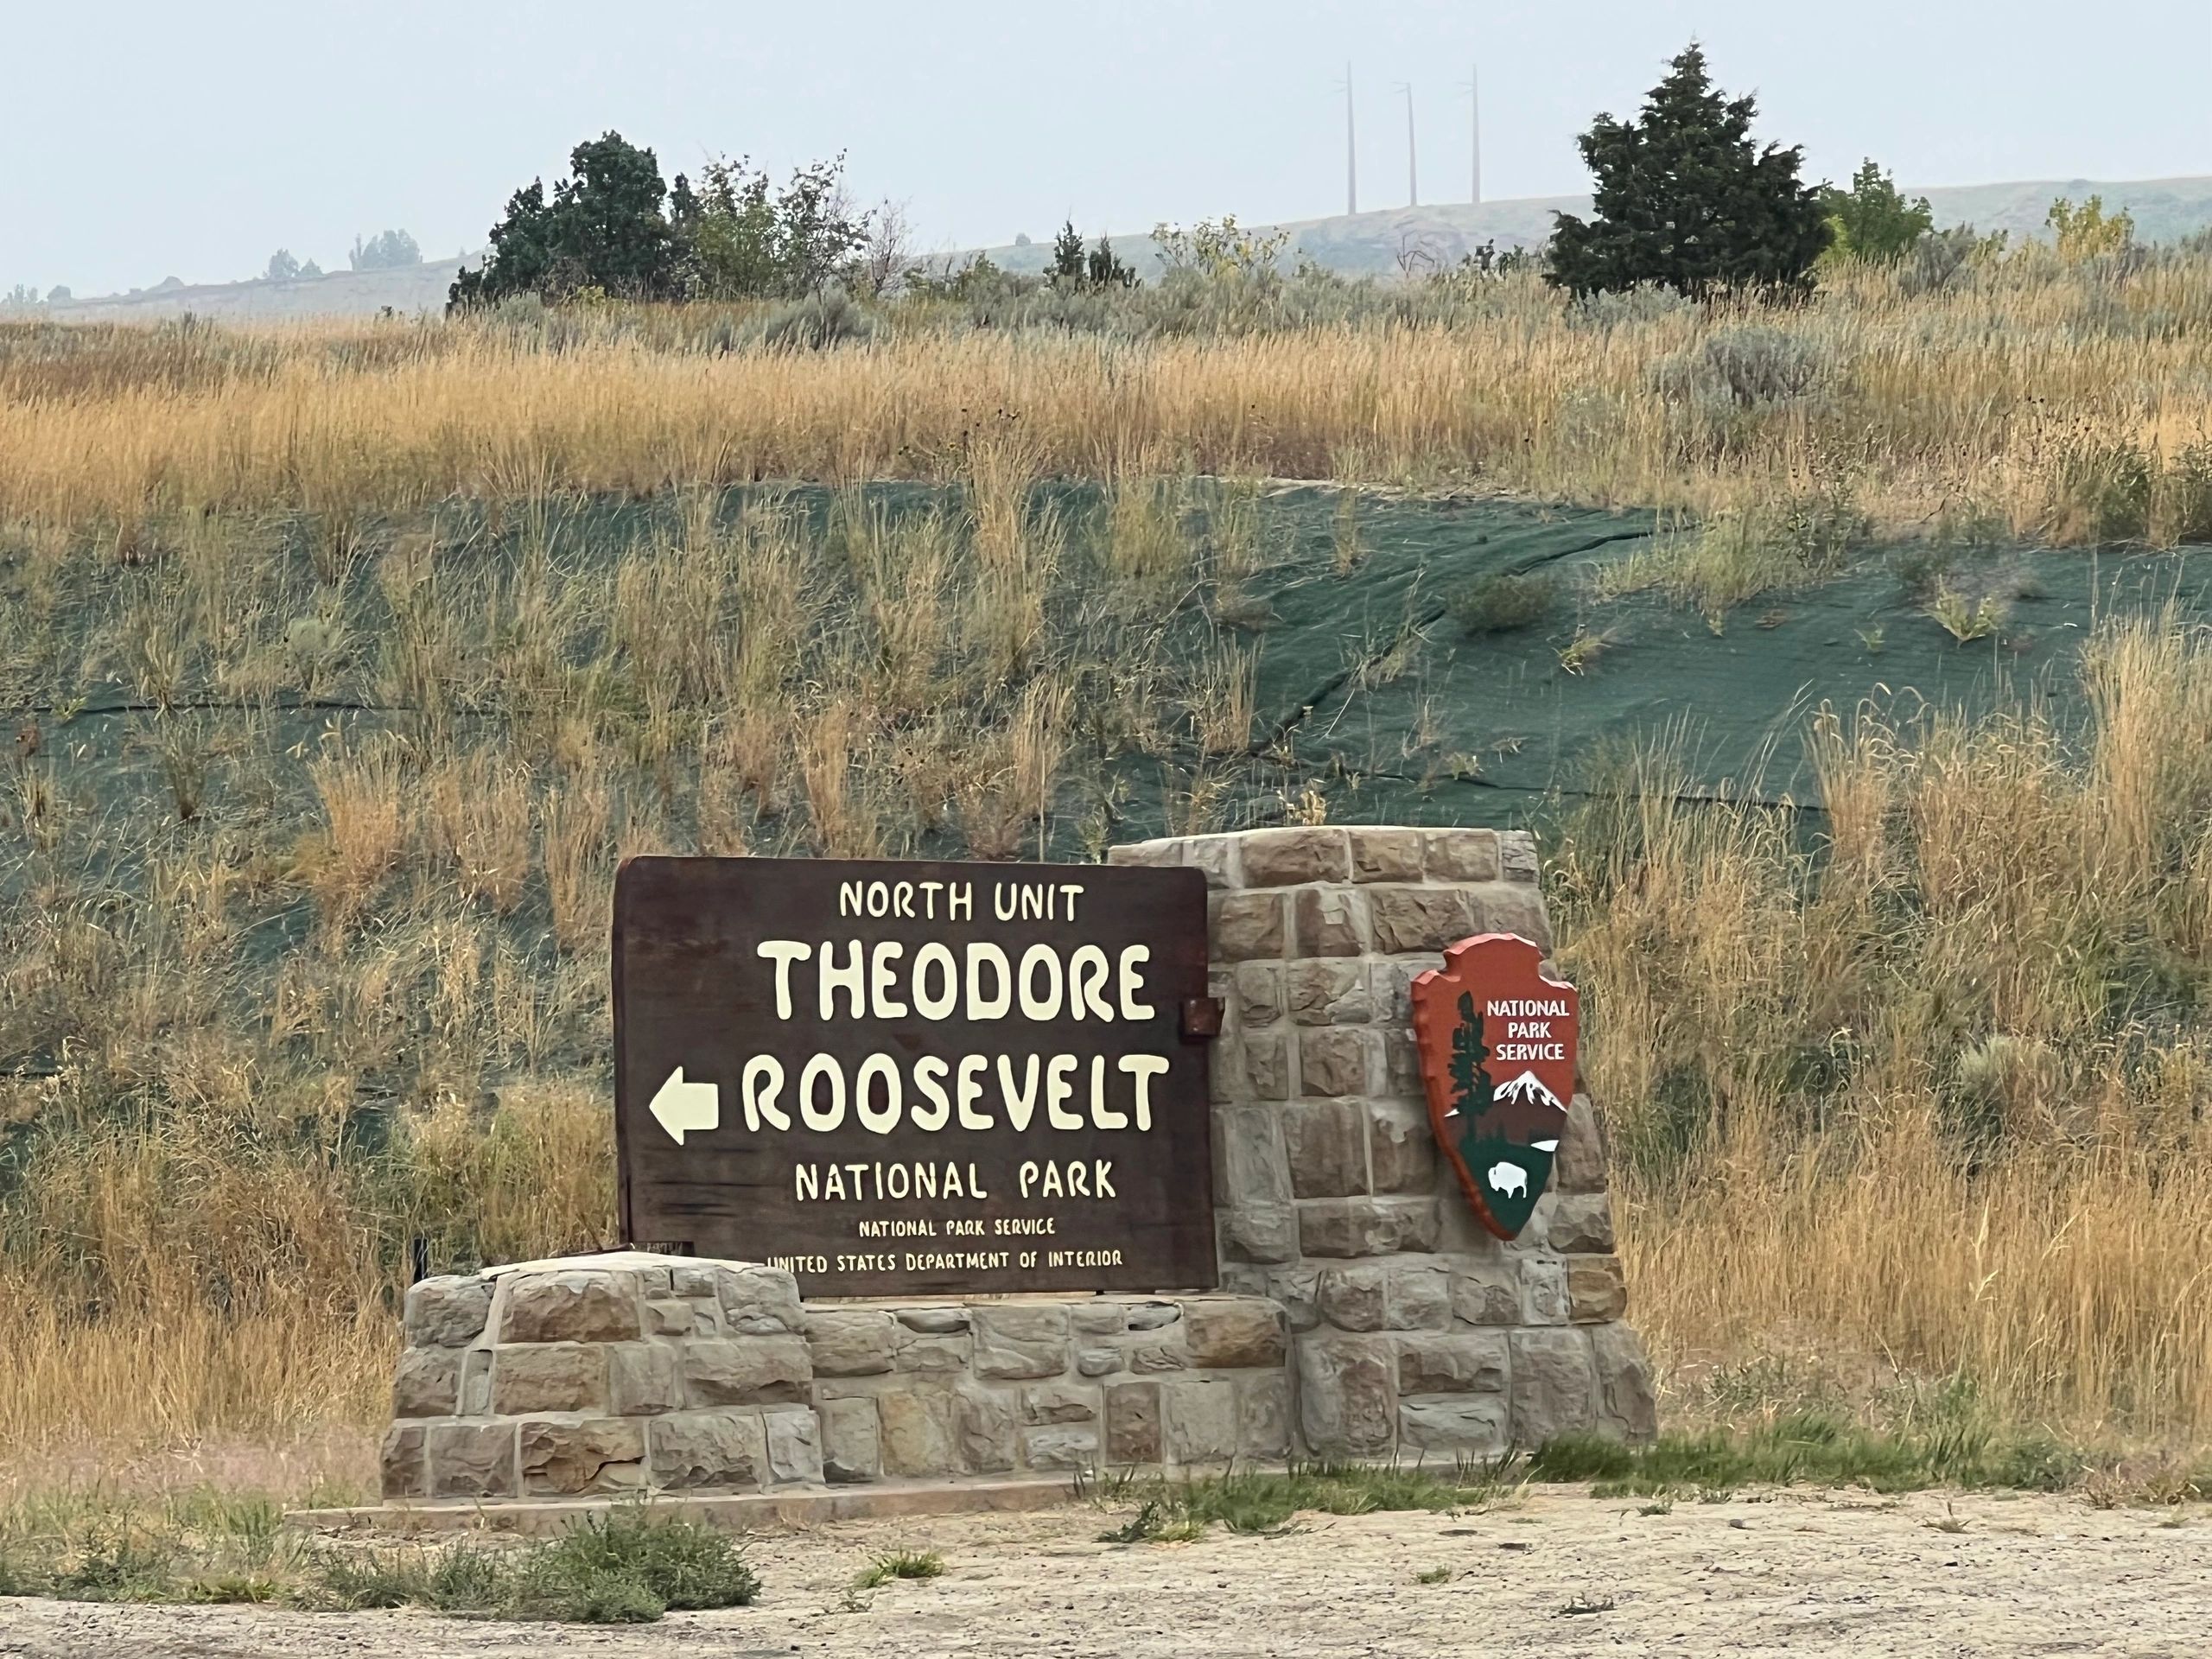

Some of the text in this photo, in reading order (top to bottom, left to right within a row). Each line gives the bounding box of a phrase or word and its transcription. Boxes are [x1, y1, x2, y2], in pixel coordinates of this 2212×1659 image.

[840, 881, 1084, 921] NORTH UNIT
[757, 939, 1154, 1022] THEODORE
[1486, 999, 1570, 1017] NATIONAL
[1508, 1021, 1552, 1039] PARK
[1496, 1043, 1566, 1061] SERVICE
[742, 1053, 1170, 1134] ROOSEVELT
[796, 1160, 1116, 1202] NATIONAL PARK
[859, 1217, 1056, 1237] NATIONAL PARK SERVICE
[836, 1255, 896, 1272] STATES
[906, 1251, 1010, 1271] DEPARTMENT
[1020, 1250, 1038, 1268] OF
[1048, 1249, 1123, 1268] INTERIOR
